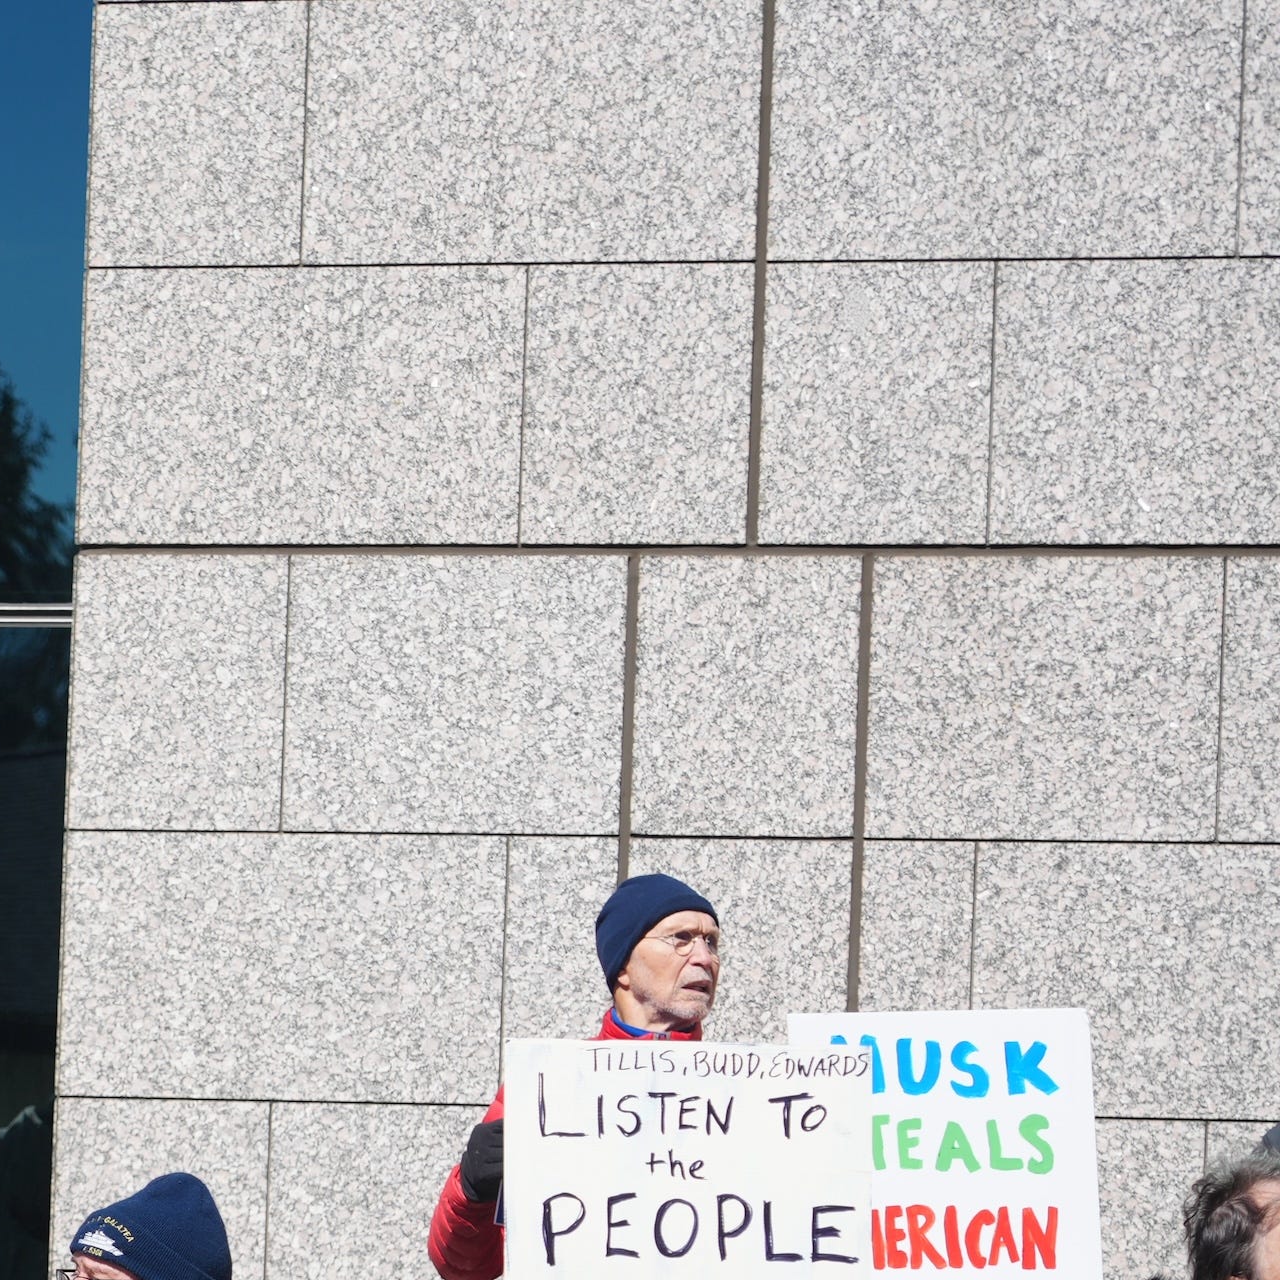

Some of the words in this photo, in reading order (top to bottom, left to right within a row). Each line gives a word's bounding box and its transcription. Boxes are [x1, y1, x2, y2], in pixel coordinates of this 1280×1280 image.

[587, 1047, 687, 1076] TILLIS,
[693, 1050, 764, 1080] BUDD,
[769, 1052, 870, 1079] EDWARDS
[538, 1072, 735, 1139] LISTEN
[768, 1092, 828, 1140] TO
[645, 1149, 707, 1181] the
[872, 1113, 1054, 1175] TEALS
[542, 1192, 860, 1267] PEOPLE
[872, 1204, 1059, 1270] ERICAN
